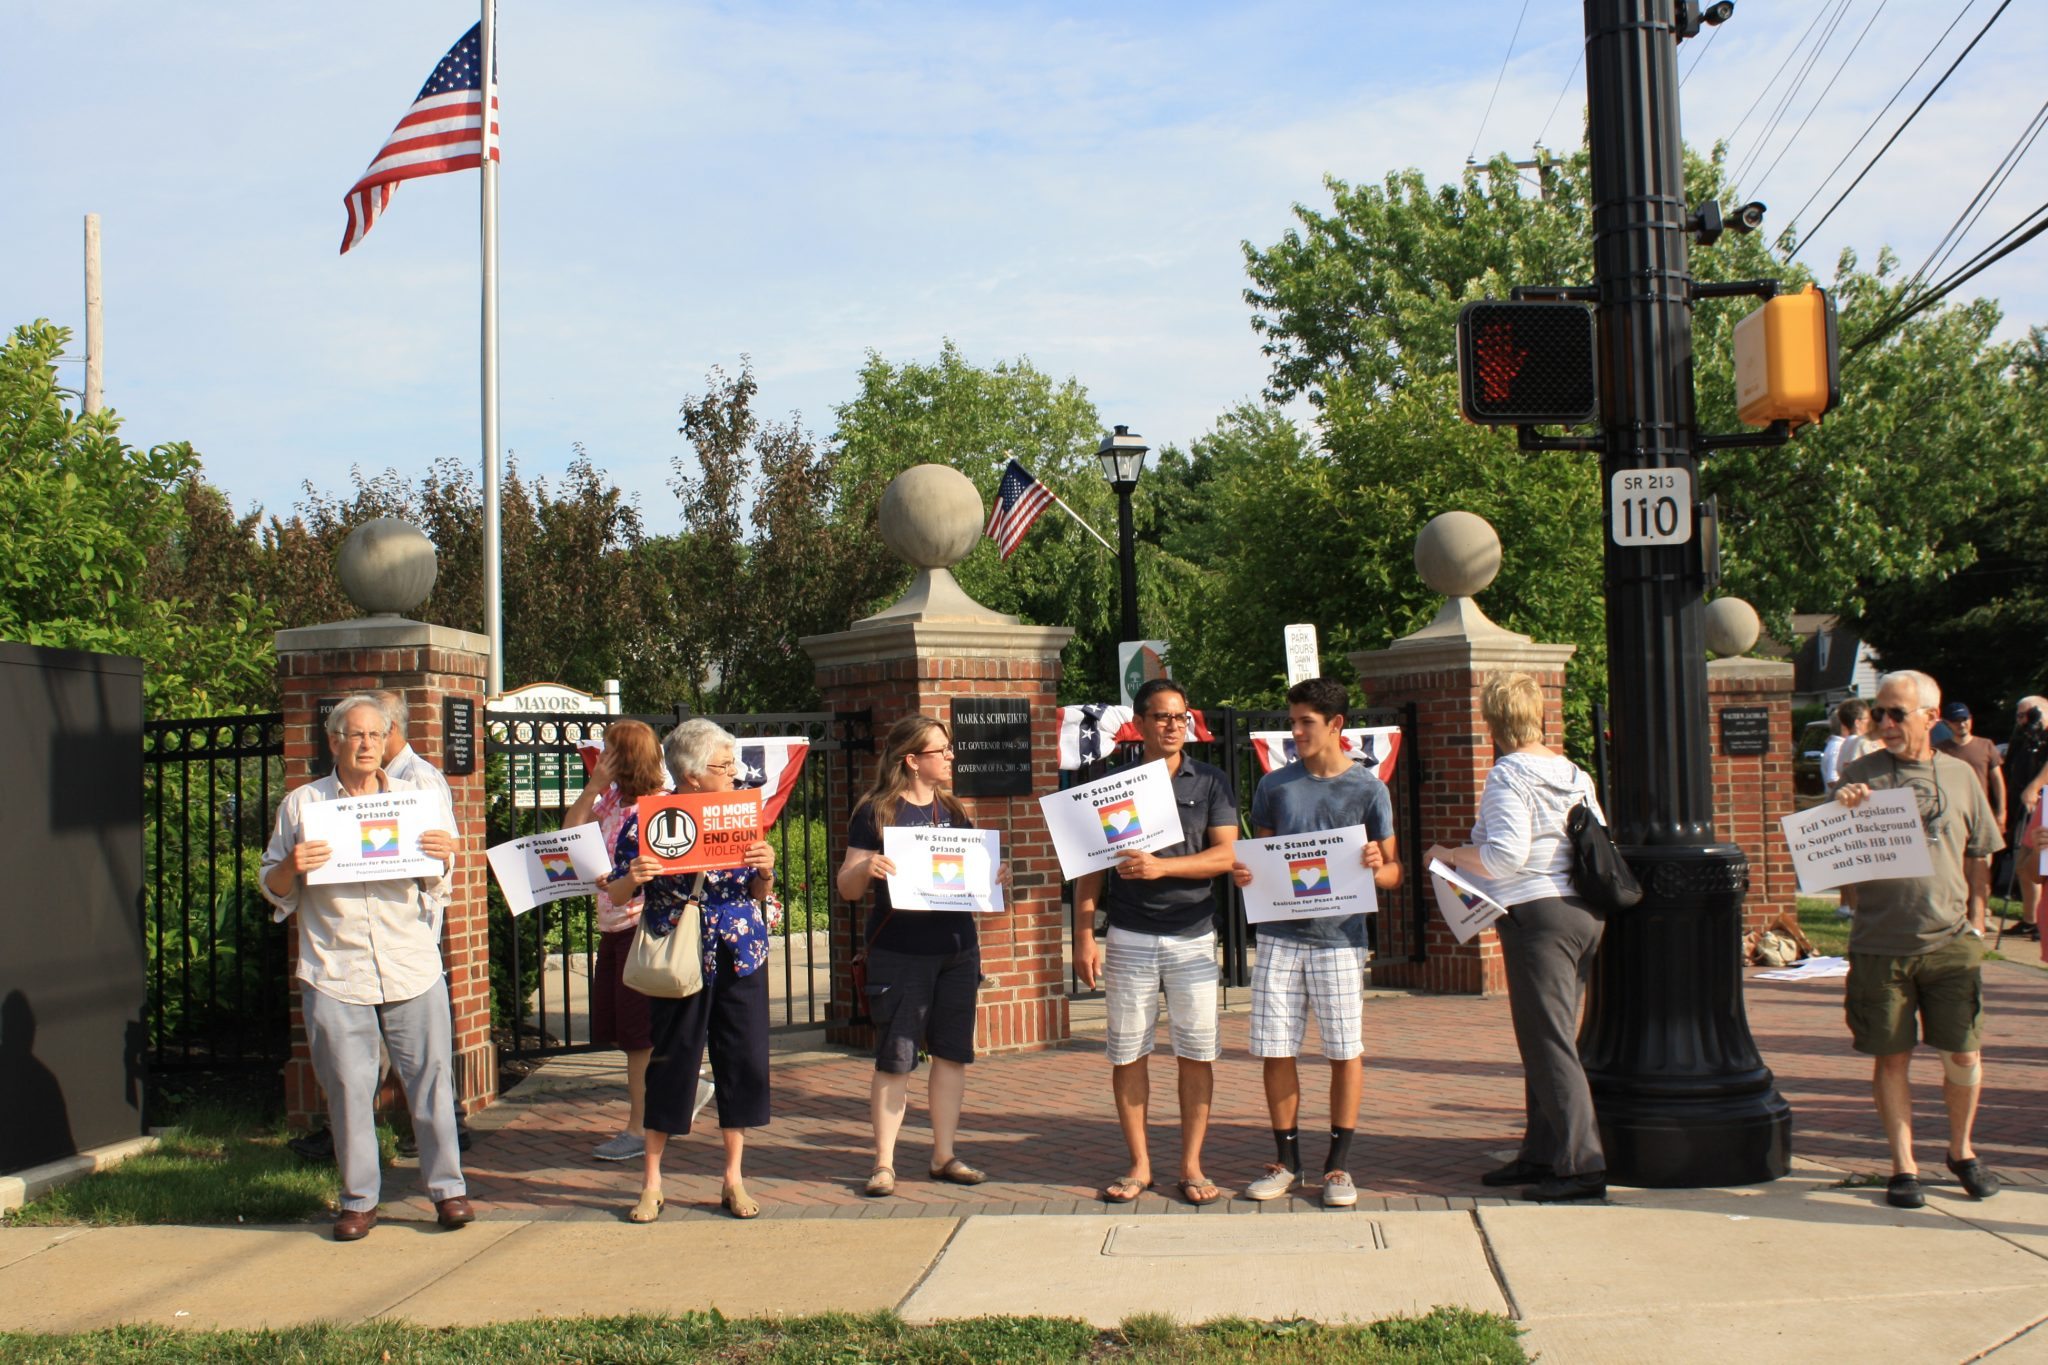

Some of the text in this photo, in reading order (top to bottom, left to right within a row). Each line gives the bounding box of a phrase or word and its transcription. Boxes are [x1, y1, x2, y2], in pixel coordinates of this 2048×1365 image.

[1624, 475, 1674, 490] SR 213
[1291, 633, 1309, 642] PARK
[1290, 644, 1314, 654] HOURS
[514, 696, 580, 710] MAYORS
[957, 713, 1028, 724] MARK S. SCHWEIKER
[958, 742, 968, 750] LT.
[968, 742, 1000, 750] GOVERNOR
[957, 764, 988, 773] GOVERNOR
[988, 764, 995, 772] OF
[1072, 773, 1148, 802] We Stand with
[336, 798, 417, 812] We Stand with
[1092, 790, 1135, 807] Orlando
[356, 810, 400, 819] Orlando
[703, 802, 757, 818] NO MORE
[703, 815, 758, 831] SILENCE
[1800, 805, 1906, 835] Tell Your Legislators
[532, 838, 558, 846] Stand
[560, 834, 581, 842] with
[703, 830, 758, 844] END GUN
[932, 835, 958, 843] Stand
[1795, 819, 1917, 851] to Support Background
[1284, 839, 1316, 850] Stand
[1319, 836, 1344, 845] with
[1808, 835, 1912, 862] Check bills HB 1010
[534, 846, 569, 855] Orlando
[1284, 850, 1328, 860] Orlando
[1832, 852, 1897, 870] and SB 1049
